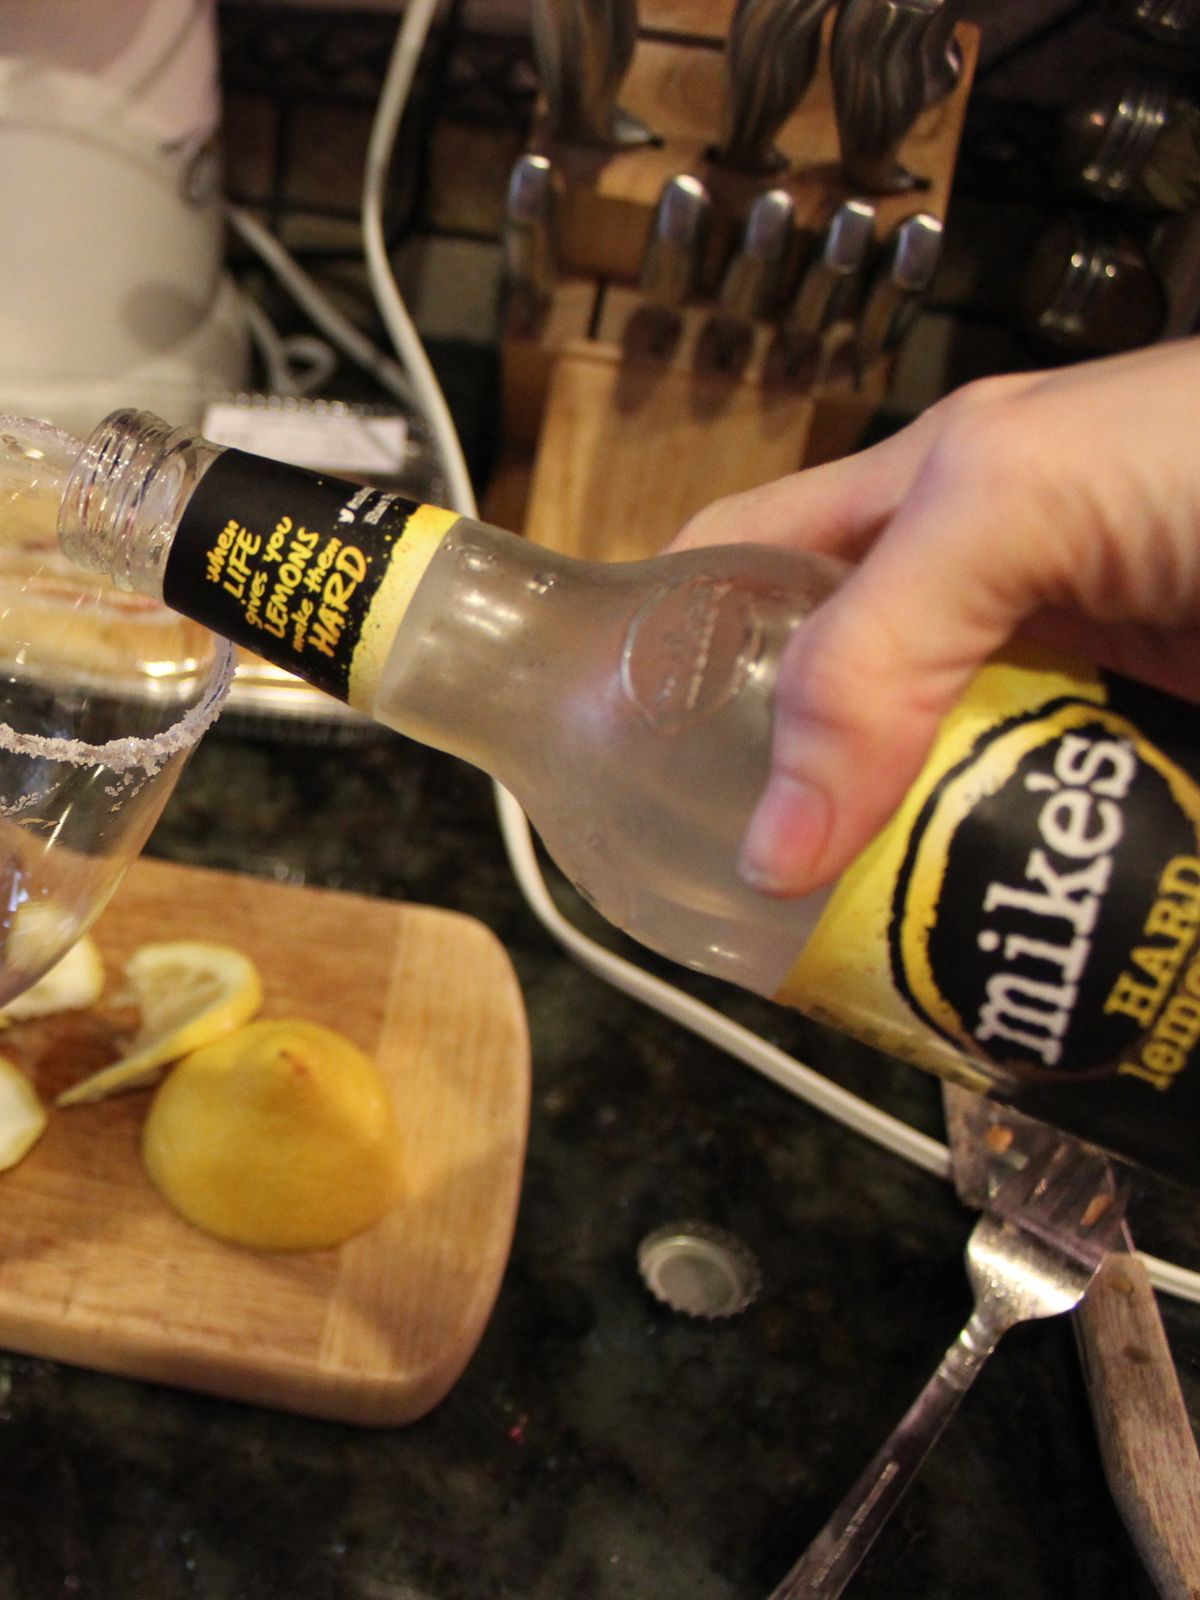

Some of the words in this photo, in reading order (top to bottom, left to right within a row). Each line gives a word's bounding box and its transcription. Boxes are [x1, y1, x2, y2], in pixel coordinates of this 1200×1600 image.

[206, 519, 240, 583] when
[223, 527, 262, 599] LIFE
[241, 570, 269, 629] gives
[262, 515, 293, 562] you
[263, 526, 320, 639] LEMONS
[292, 598, 314, 653] make
[303, 537, 343, 594] them
[974, 734, 1137, 1066] mike's
[1103, 855, 1200, 1029] HARD
